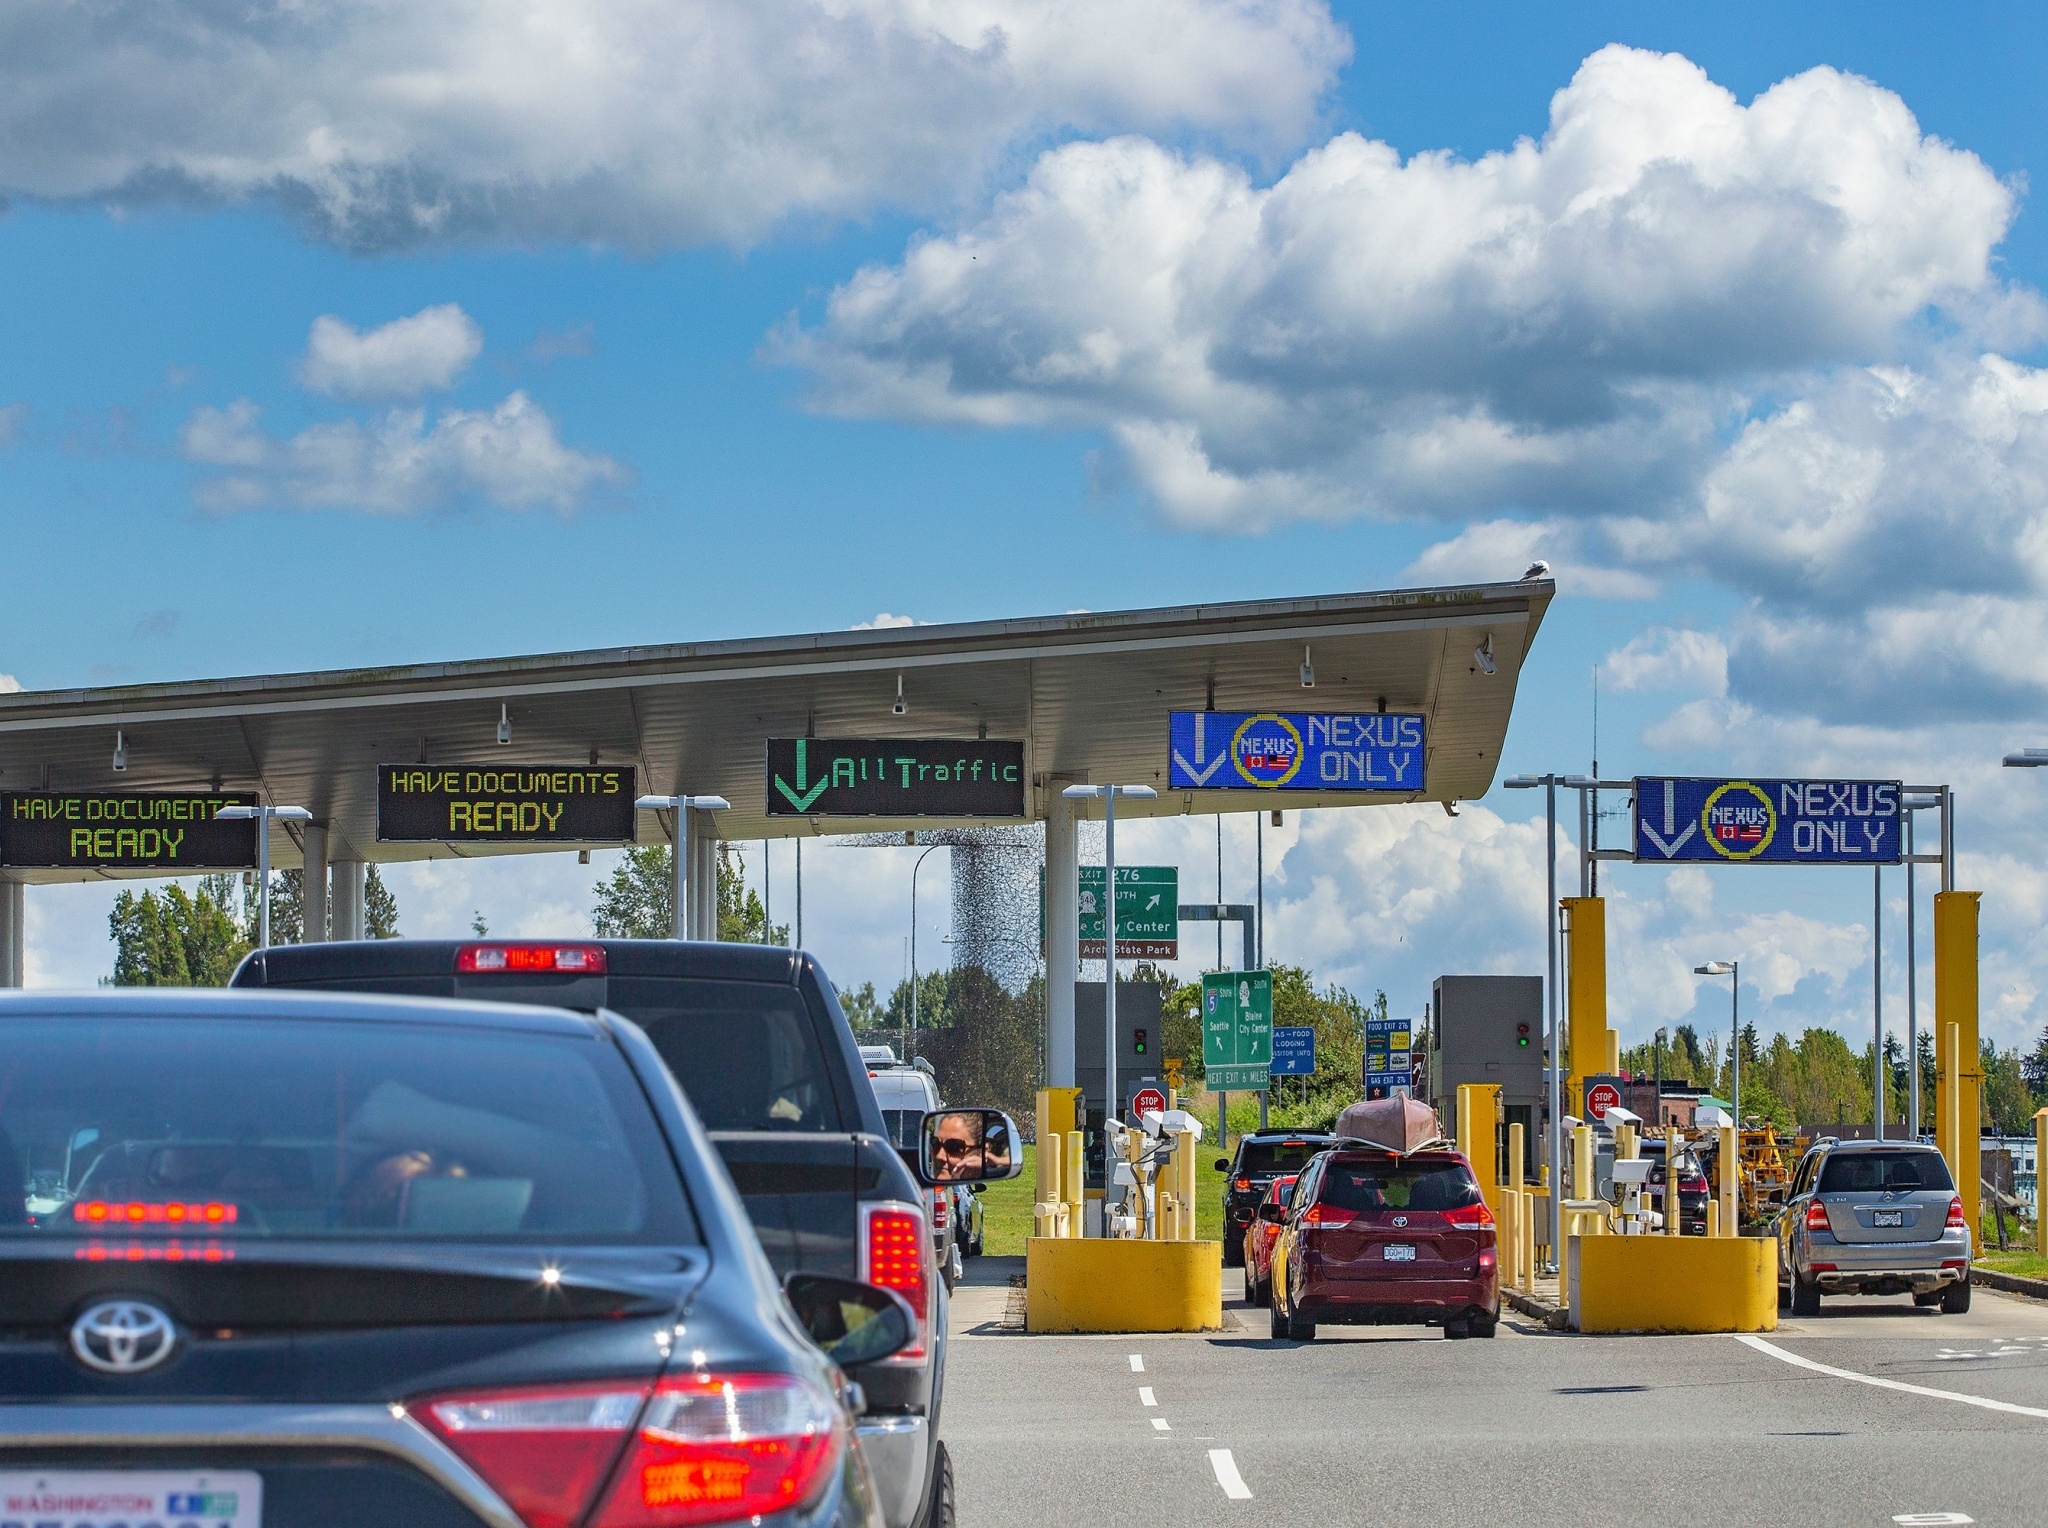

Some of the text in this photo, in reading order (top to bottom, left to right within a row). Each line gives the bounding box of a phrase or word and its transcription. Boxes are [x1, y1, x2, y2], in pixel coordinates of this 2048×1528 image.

[1308, 716, 1421, 748] NEXUS
[1240, 737, 1296, 754] NEXUS
[832, 757, 1018, 788] All Traffic
[1320, 751, 1410, 782] ONLY
[392, 771, 620, 794] HAVE DOCUMENTS
[1781, 783, 1897, 816] NEXUS
[13, 798, 82, 820] HAVE
[450, 801, 564, 832] READY
[1711, 807, 1768, 825] NEXUS
[71, 828, 184, 858] READY
[1793, 820, 1886, 853] ONLY
[1103, 891, 1137, 900] SUTH
[1093, 920, 1120, 934] Ciy
[1126, 921, 1170, 932] Center
[1146, 945, 1171, 955] Park
[1209, 995, 1215, 1012] 5
[1210, 1021, 1230, 1031] Seattle
[1239, 1024, 1268, 1035] City Center
[1292, 1030, 1310, 1038] FOOD
[1368, 1021, 1409, 1031] FOOD EXIT 276
[1276, 1040, 1306, 1048] LODGING
[1207, 1070, 1268, 1085] NEXT EXIT 6 MILES
[1370, 1077, 1381, 1085] GAS
[1397, 1076, 1406, 1084] 276
[1140, 1096, 1159, 1106] STOP
[1594, 1092, 1613, 1102] STOP
[6, 1493, 154, 1514] WASHINGTON
